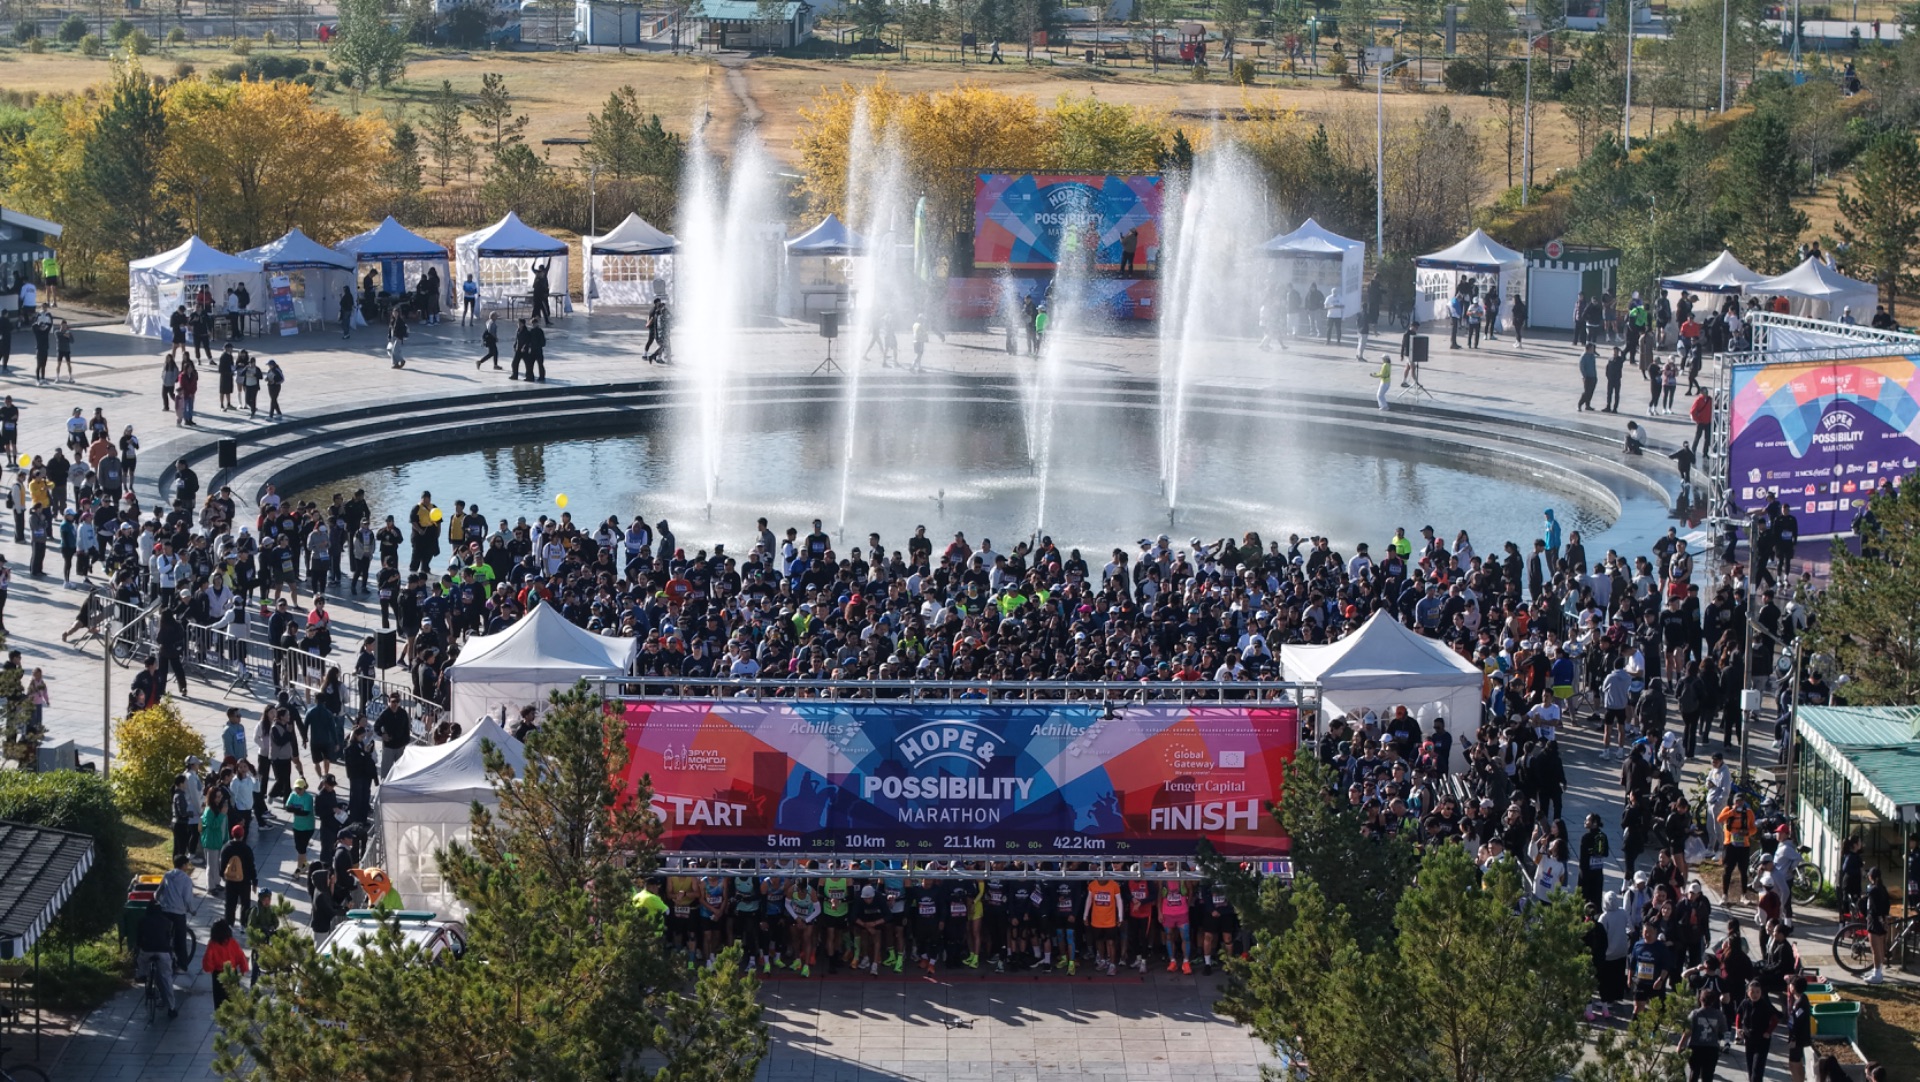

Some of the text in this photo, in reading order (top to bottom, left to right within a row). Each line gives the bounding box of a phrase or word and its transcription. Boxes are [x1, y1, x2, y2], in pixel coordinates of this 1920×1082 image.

[1049, 189, 1081, 207] HOPE
[1823, 413, 1847, 429] HOPE
[1812, 430, 1864, 444] POSSIBILITY
[789, 721, 844, 734] Achilles
[1030, 723, 1085, 736] Achilles
[899, 728, 995, 763] HOPE &
[1173, 750, 1204, 759] Global
[1173, 760, 1215, 770] Gateway
[864, 776, 1034, 800] POSSIBILITY
[1163, 779, 1246, 794] Tenger Capital
[647, 793, 747, 827] START
[898, 807, 1001, 823] MARATHON
[1150, 798, 1259, 831] FINISH
[767, 834, 777, 847] 5
[779, 833, 801, 847] km
[845, 834, 862, 848] 10
[863, 834, 886, 848] km
[943, 834, 972, 848] 21.1
[973, 834, 996, 848] km
[1052, 836, 1082, 849] 42.2
[1083, 835, 1106, 849] km
